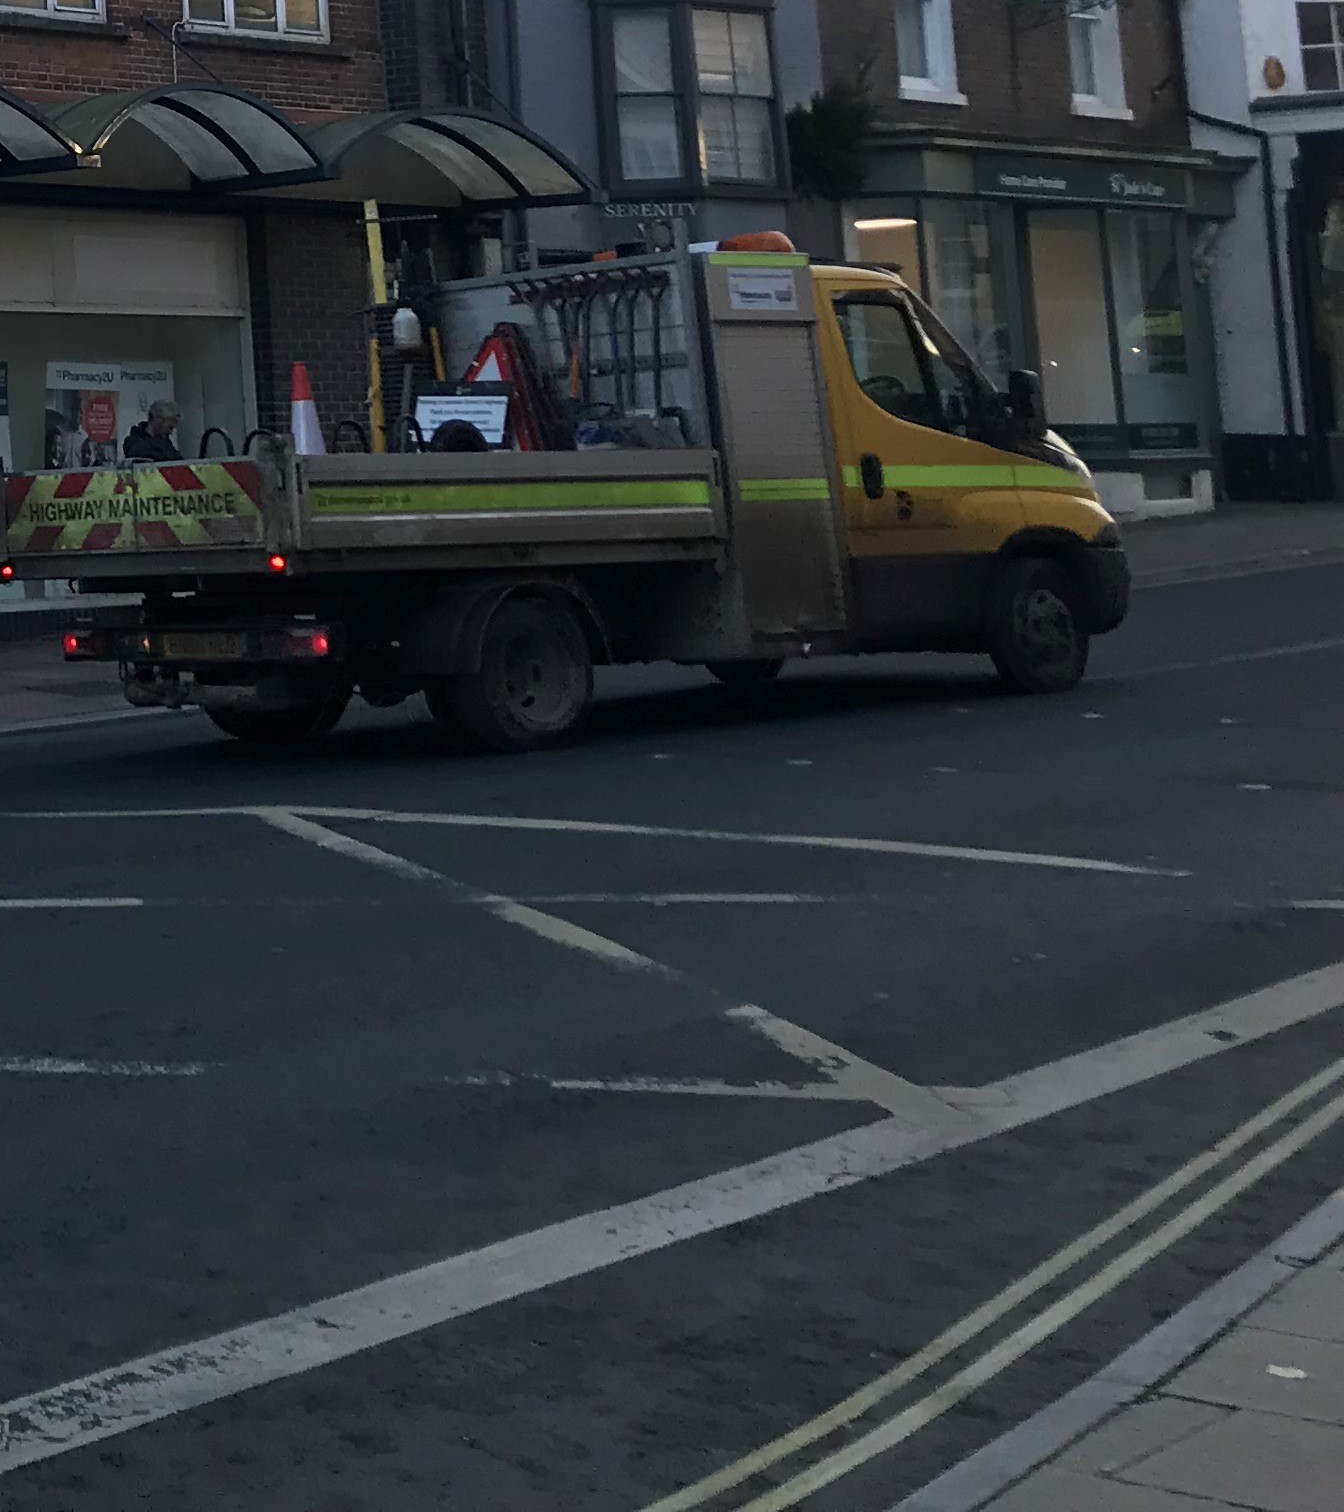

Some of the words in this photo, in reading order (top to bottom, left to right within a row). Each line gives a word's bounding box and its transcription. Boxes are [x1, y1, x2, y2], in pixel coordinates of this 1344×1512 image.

[604, 202, 699, 218] SERENITY
[63, 369, 114, 385] Pharmacy2U
[29, 499, 104, 522] HIGHWAY
[108, 492, 238, 518] MAINTENANCE
